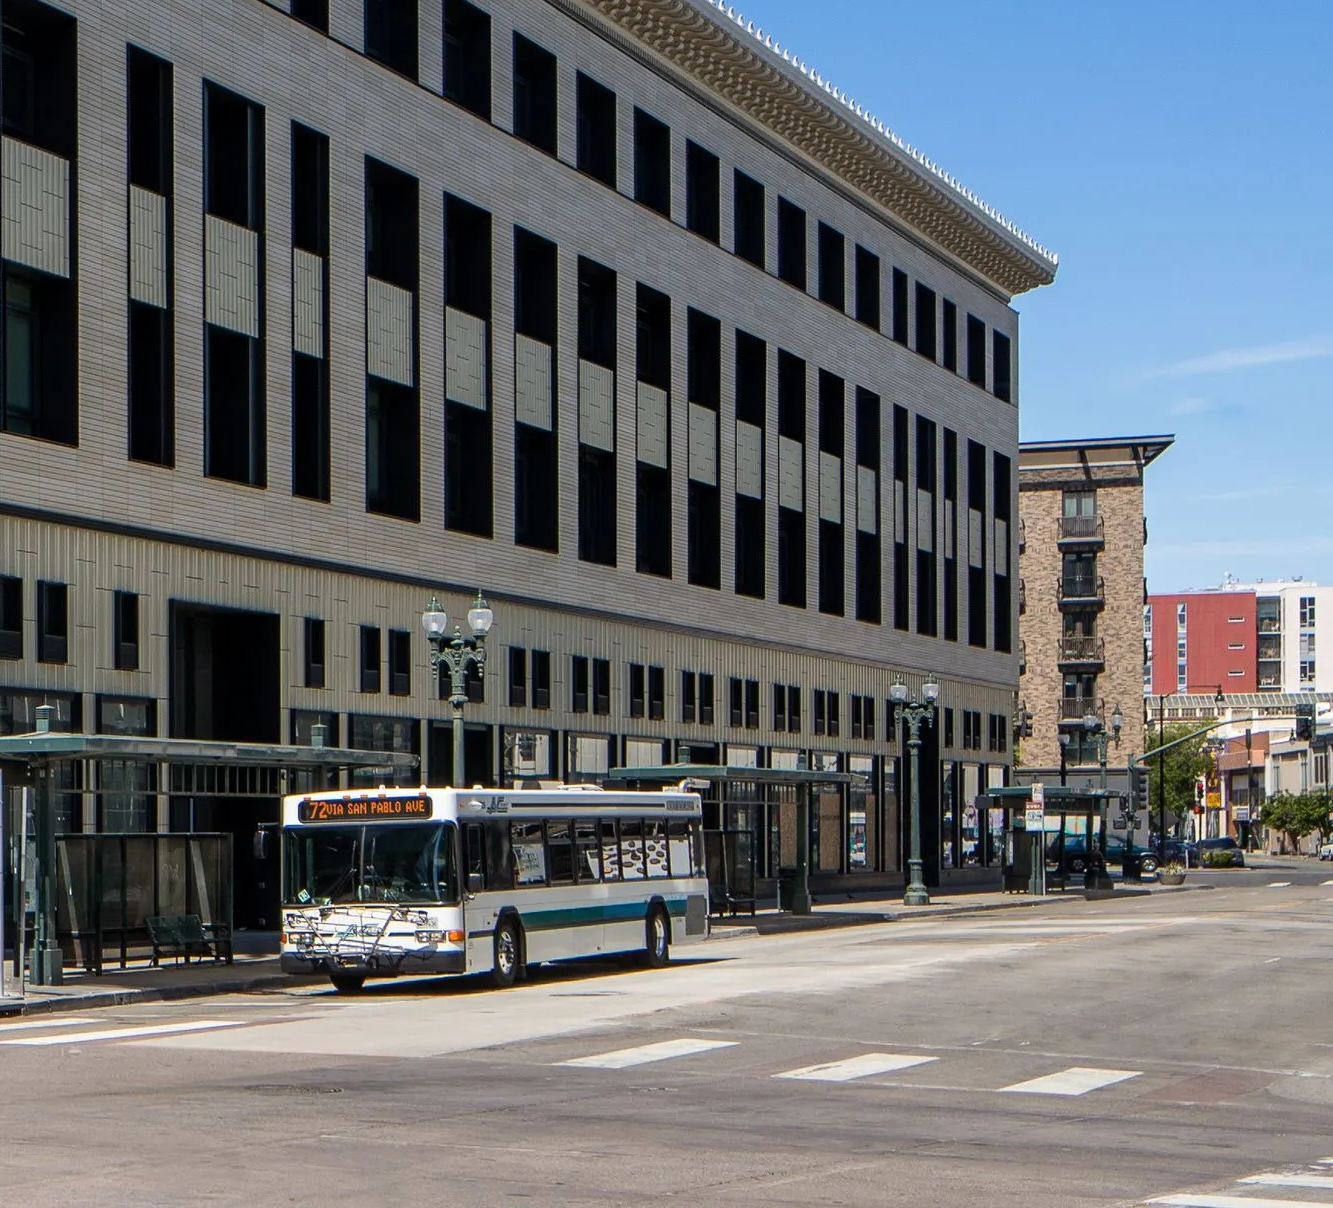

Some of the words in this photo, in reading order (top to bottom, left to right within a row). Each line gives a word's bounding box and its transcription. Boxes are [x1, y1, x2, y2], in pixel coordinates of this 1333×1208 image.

[347, 802, 367, 815] SAN
[370, 801, 401, 814] PABLO
[405, 799, 425, 812] AVE
